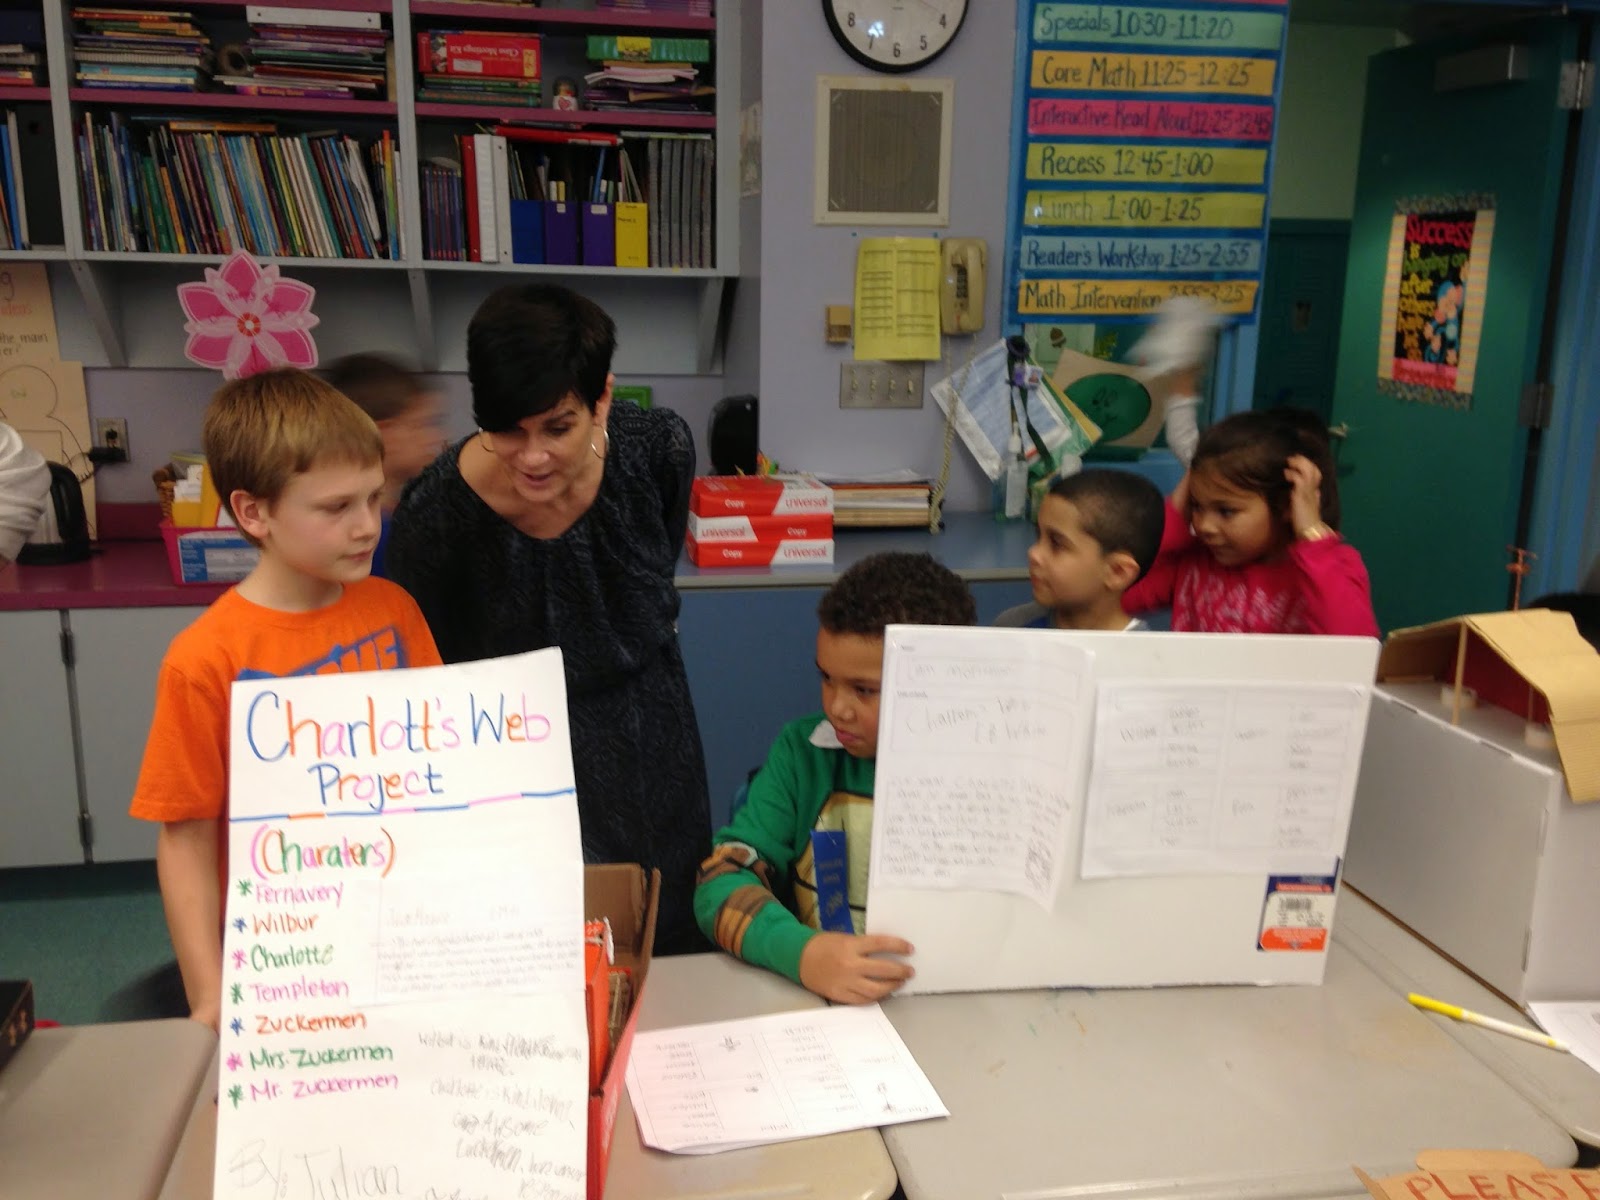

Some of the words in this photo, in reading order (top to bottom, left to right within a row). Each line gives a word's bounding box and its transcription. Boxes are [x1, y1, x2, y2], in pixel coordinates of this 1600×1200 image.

[848, 12, 856, 27] 8
[939, 13, 947, 28] 4
[1041, 8, 1111, 40] Specials
[893, 42, 901, 57] 6
[920, 35, 928, 50] 5
[1042, 56, 1082, 85] Core
[1088, 57, 1136, 89] Math
[1031, 100, 1110, 127] Interactive
[1115, 105, 1149, 129] Read
[1042, 146, 1105, 176] Recess
[1037, 193, 1093, 221] Lunch
[1103, 194, 1204, 222] 1:00-1:25
[1027, 240, 1092, 267] Reader's
[1024, 282, 1066, 309] Math
[1070, 282, 1163, 311] Intervention
[724, 498, 745, 508] Copy
[787, 527, 808, 538] Copy
[722, 549, 743, 559] Copy
[246, 690, 461, 763] Charlott's
[469, 691, 551, 746] Web
[307, 762, 445, 813] Project
[250, 824, 397, 880] (Charaters)
[254, 882, 344, 909] Fernavery
[252, 913, 319, 936] Wilbur
[250, 943, 334, 972] Charlotte
[250, 976, 349, 1004] Templeton
[249, 1049, 290, 1071] Mrs.
[250, 1079, 283, 1102] Mr.
